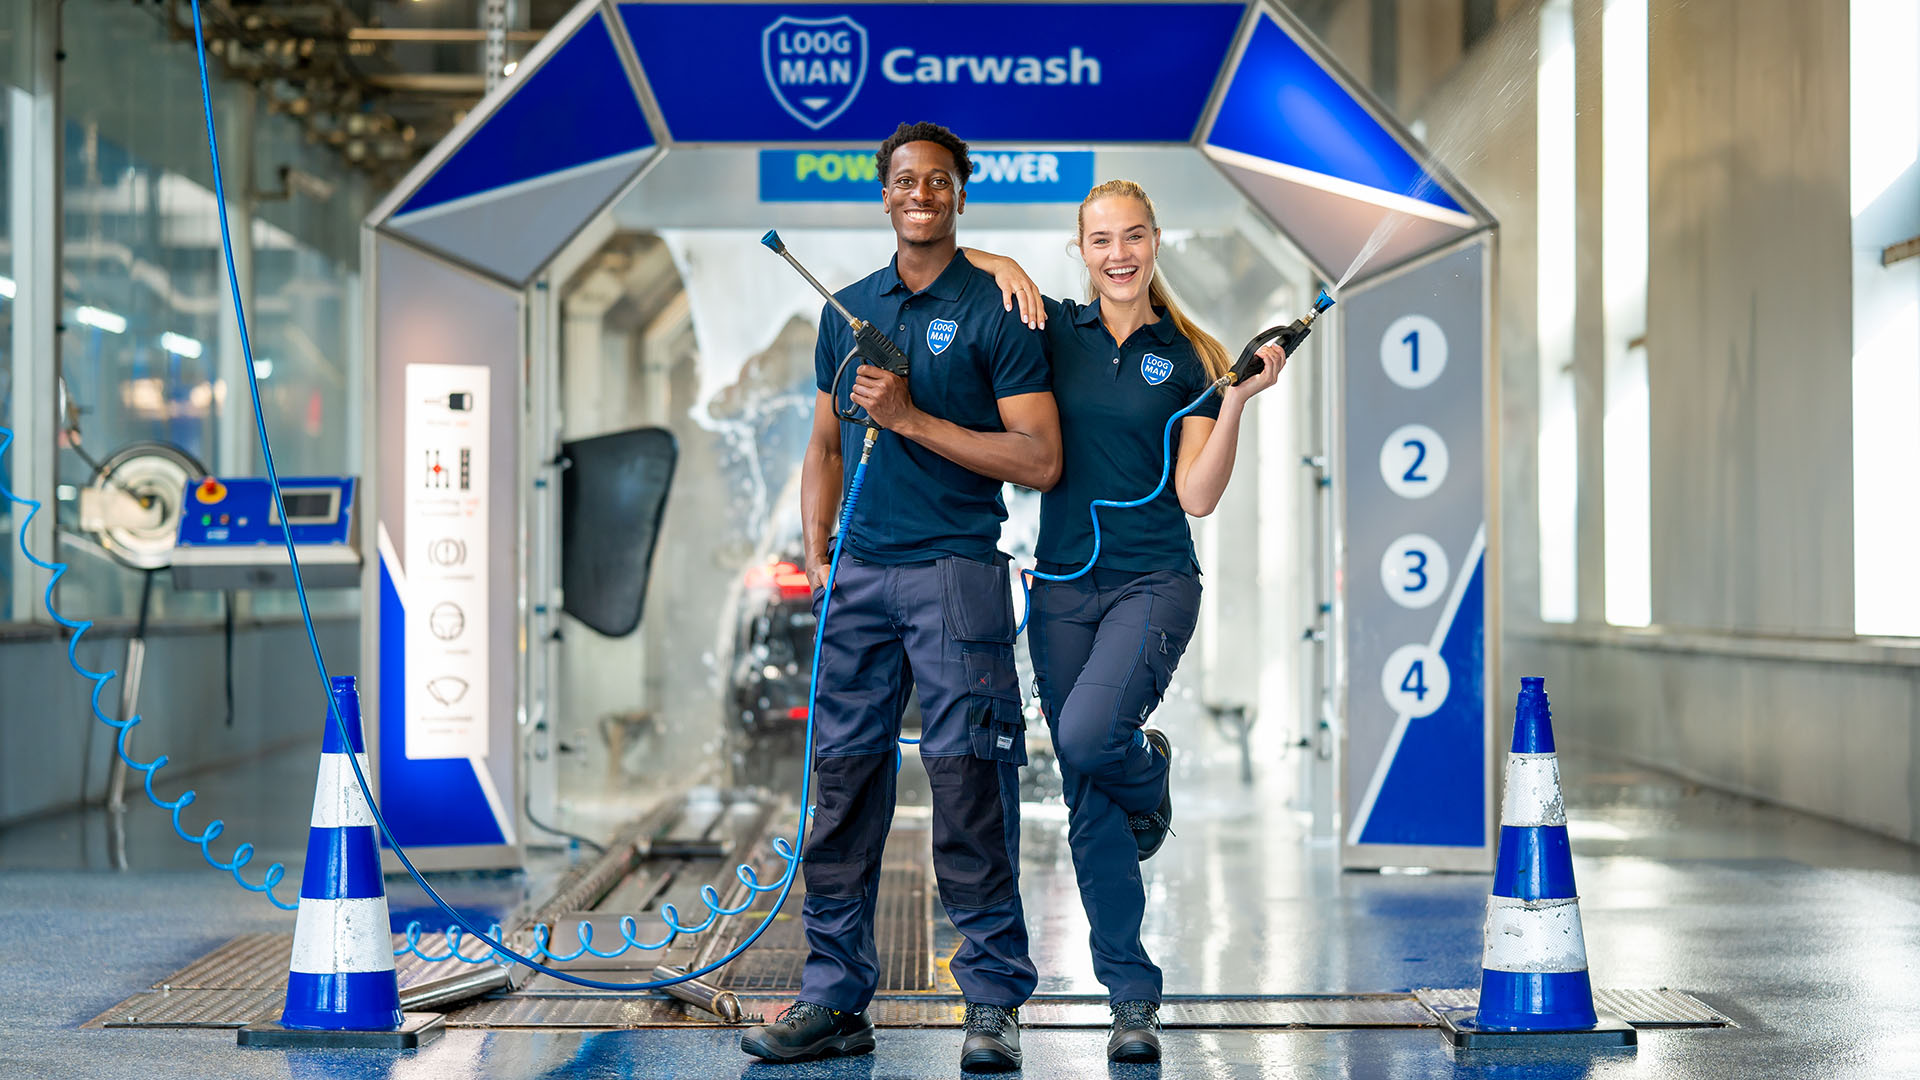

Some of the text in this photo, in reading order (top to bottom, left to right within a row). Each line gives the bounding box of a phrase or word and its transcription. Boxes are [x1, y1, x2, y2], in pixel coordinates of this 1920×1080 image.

[780, 31, 850, 54] LOOG
[780, 60, 850, 84] MAN
[882, 47, 1100, 85] Carwash
[796, 153, 1059, 183] POW OWER
[930, 331, 951, 342] MAN
[933, 323, 954, 332] LOOG
[1147, 357, 1169, 370] LOOG
[1402, 330, 1419, 372] 1
[1144, 365, 1167, 377] MAN
[1402, 440, 1428, 482] 2
[1403, 550, 1428, 592] 3
[1400, 660, 1428, 701] 4
